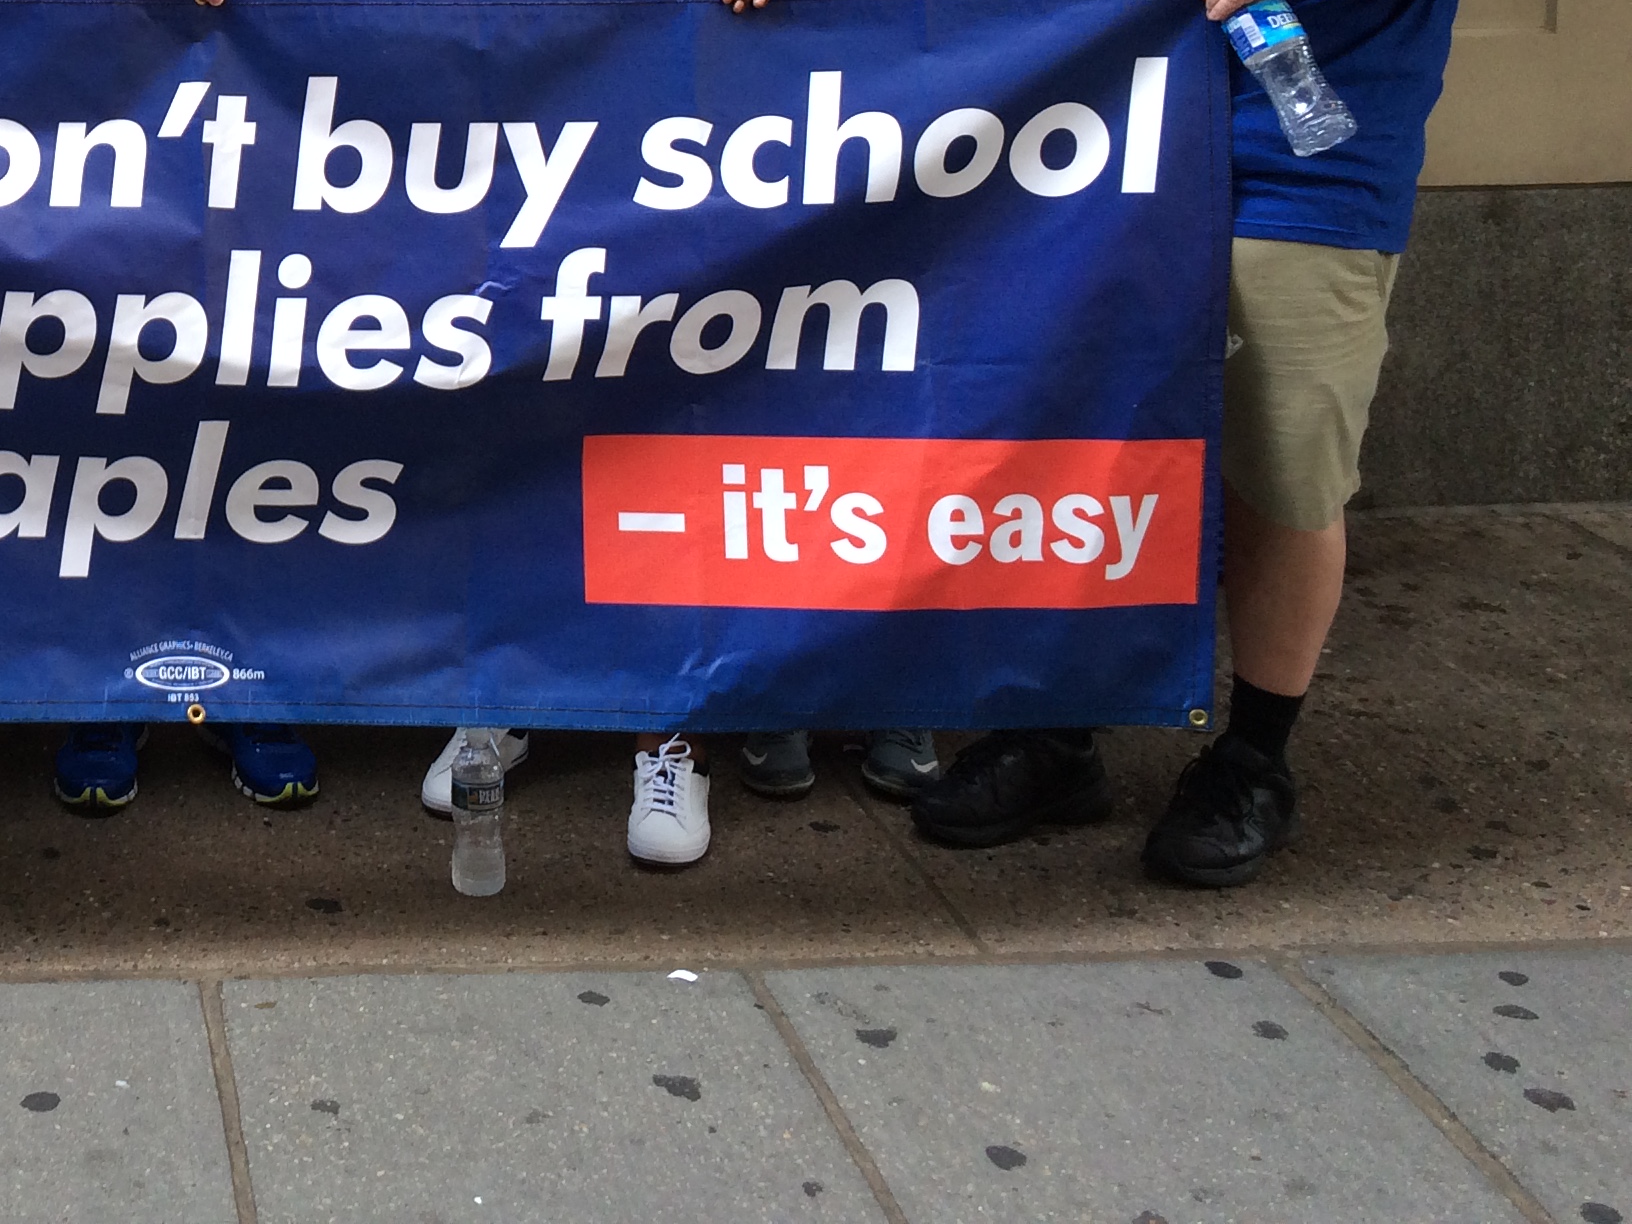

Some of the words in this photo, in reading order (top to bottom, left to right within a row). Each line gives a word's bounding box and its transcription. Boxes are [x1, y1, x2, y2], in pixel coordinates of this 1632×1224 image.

[292, 75, 598, 248] buy
[632, 56, 1169, 211] school
[540, 247, 921, 382] from
[721, 463, 888, 564] it's
[926, 492, 1160, 581] easy
[158, 666, 207, 680] GCC/IBT
[232, 668, 265, 680] 866m
